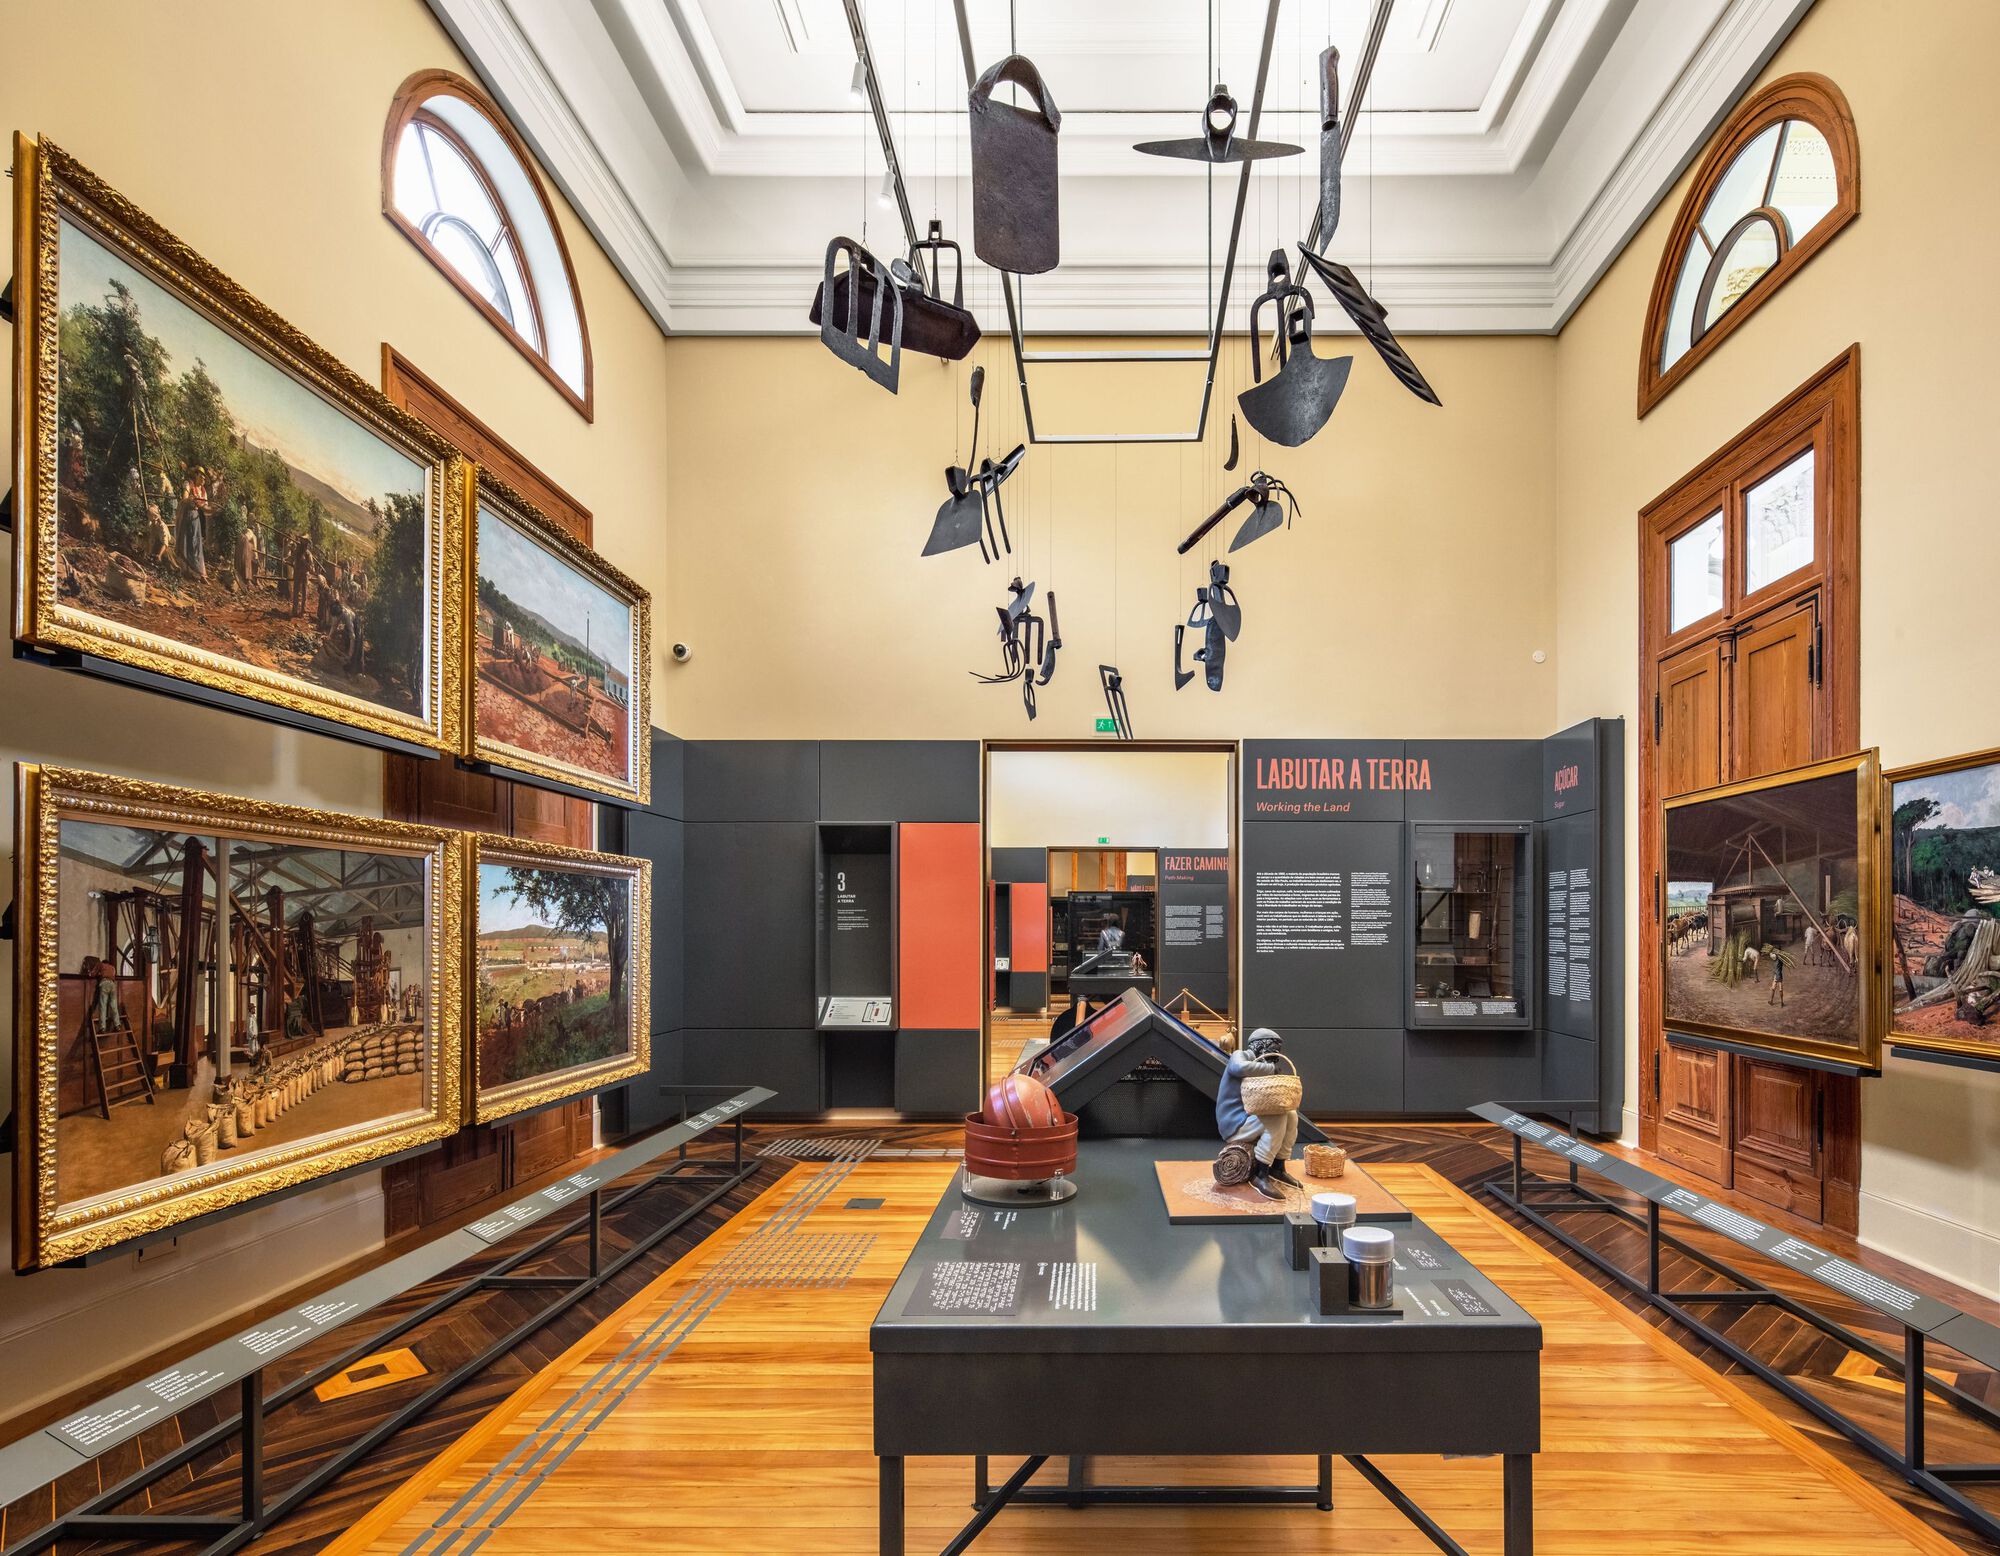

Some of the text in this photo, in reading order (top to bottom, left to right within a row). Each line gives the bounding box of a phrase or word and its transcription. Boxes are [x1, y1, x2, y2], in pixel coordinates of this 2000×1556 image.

[1256, 758, 1432, 790] LABUTAR A TERRA
[1554, 765, 1578, 795] AÇÚCAR
[1256, 802, 1350, 814] Working the Land
[1164, 856, 1192, 870] FAZER
[837, 872, 846, 891] 3
